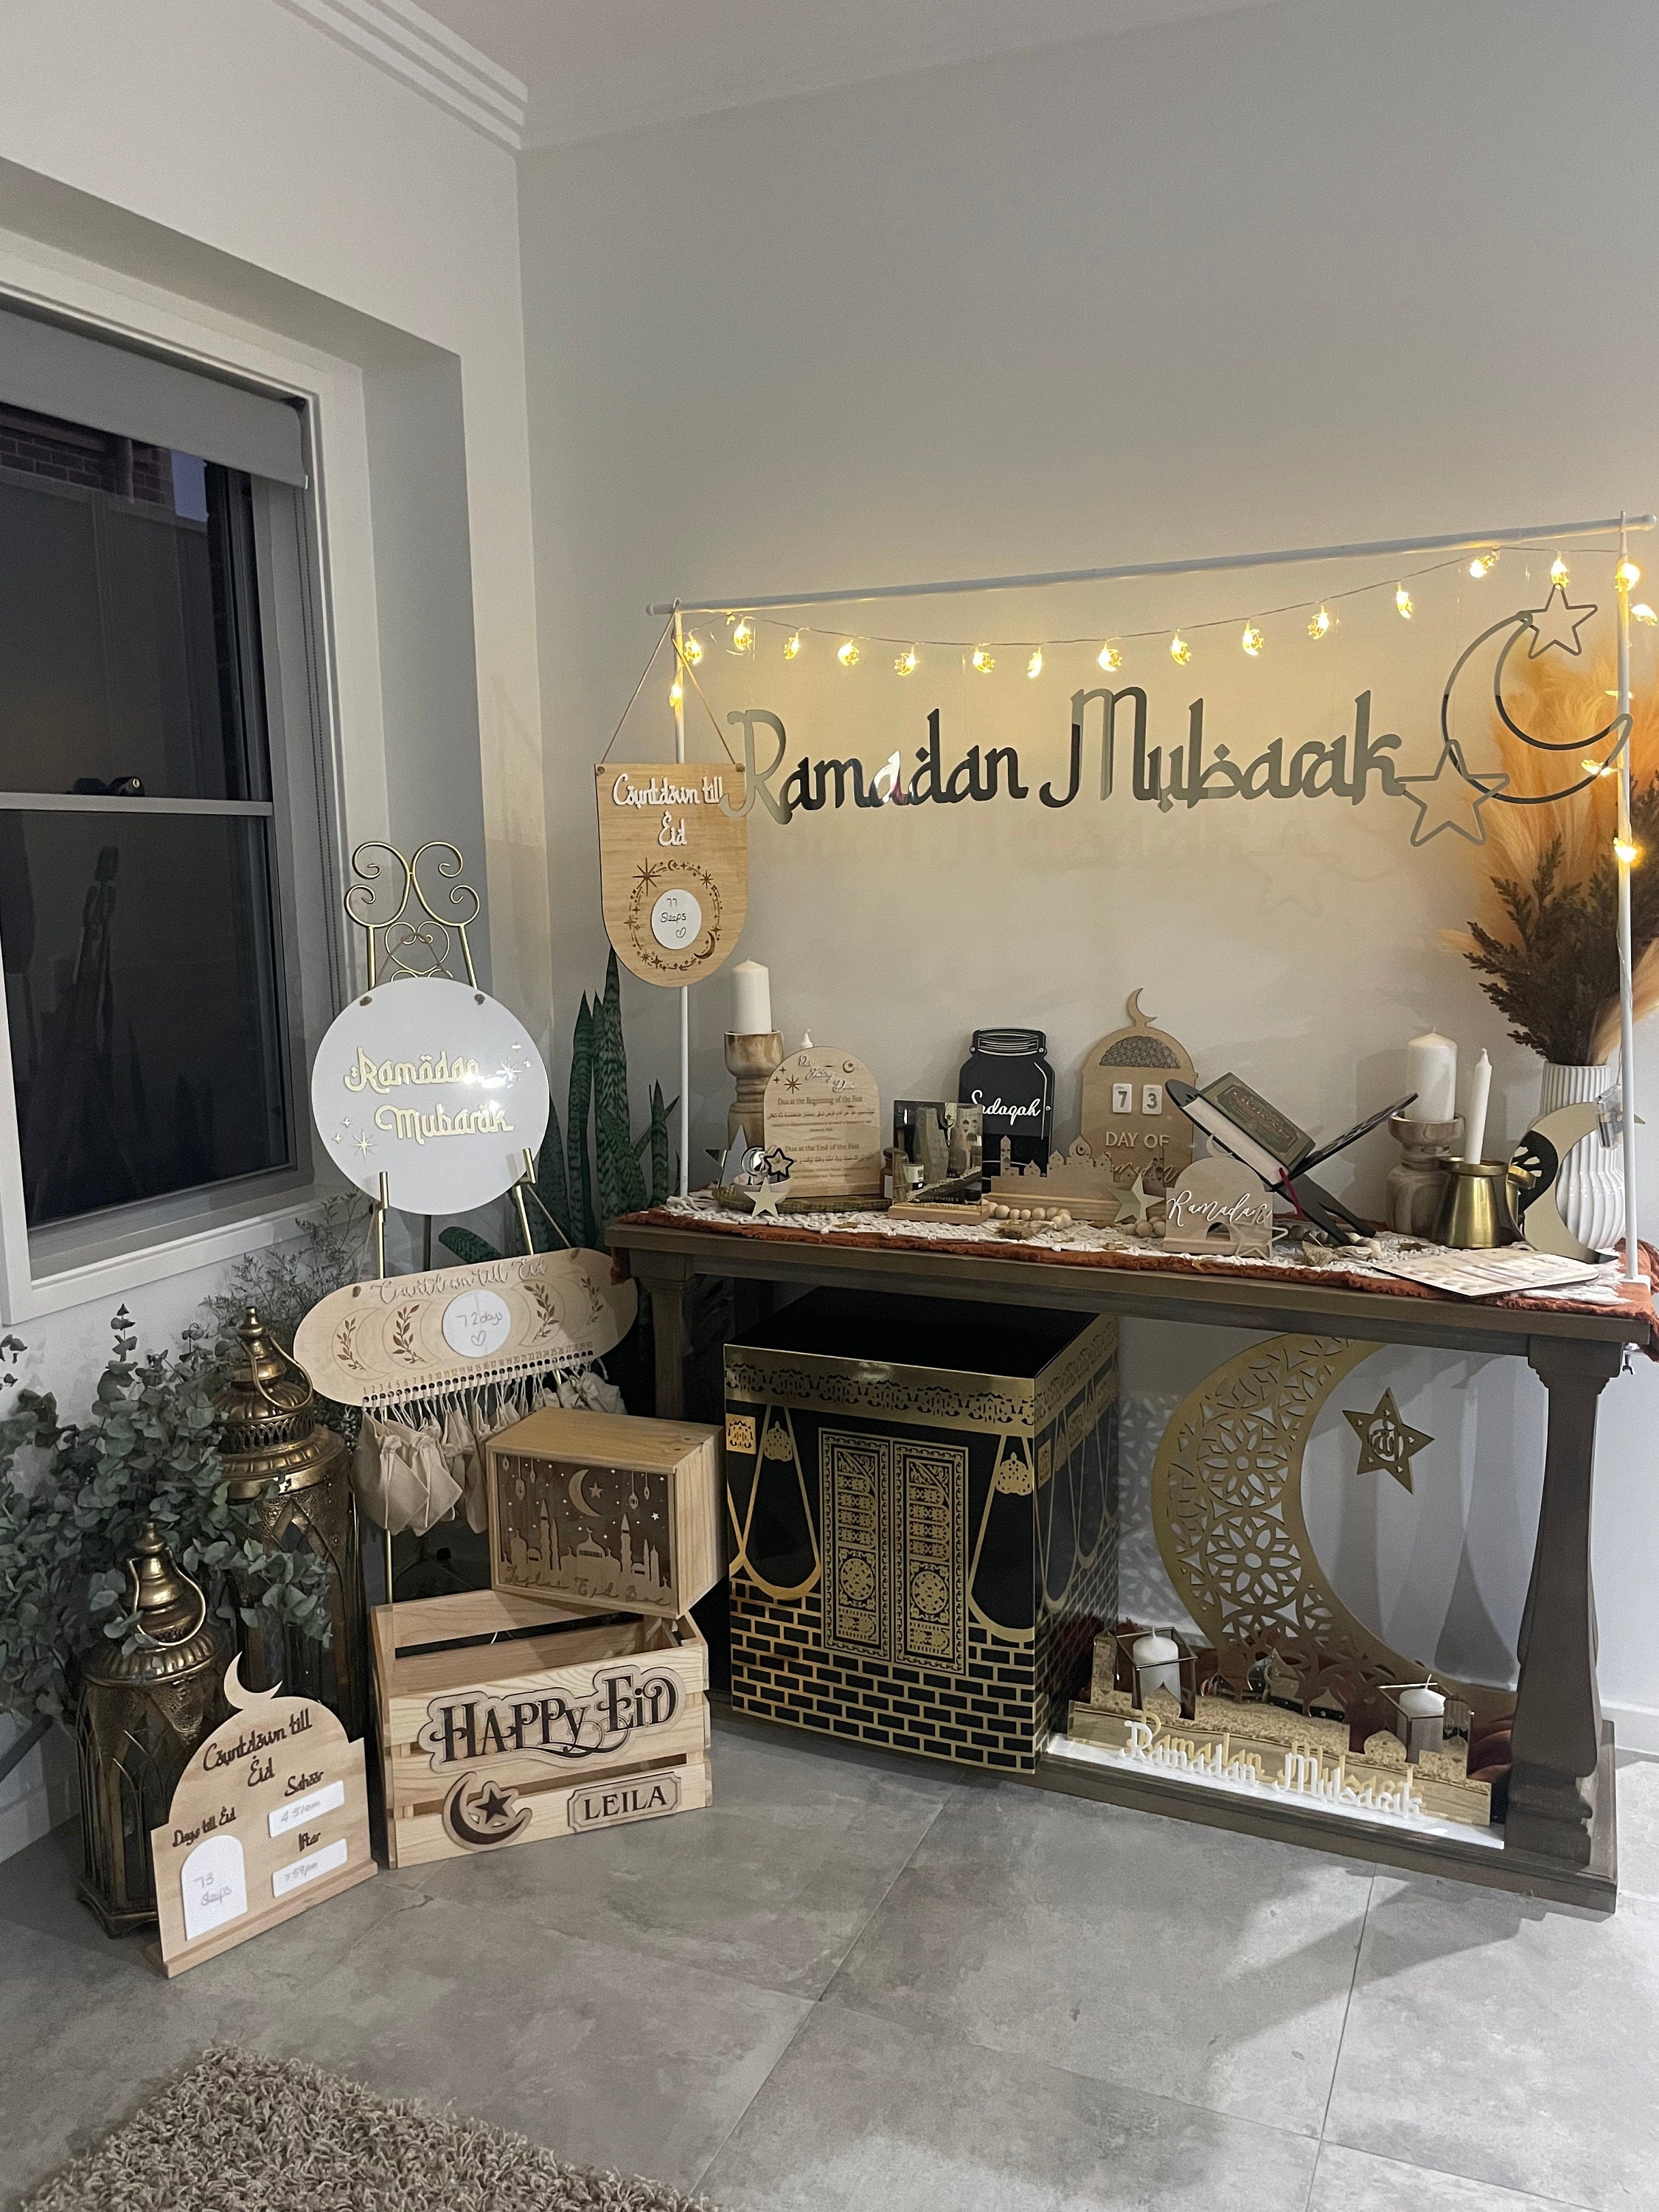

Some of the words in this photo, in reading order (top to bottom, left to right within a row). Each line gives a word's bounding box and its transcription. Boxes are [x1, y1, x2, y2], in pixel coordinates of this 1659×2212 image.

[719, 708, 1029, 824] Ramadan
[1038, 686, 1407, 813] Mubarak
[613, 773, 700, 809] Countdown
[702, 776, 723, 804] till
[658, 810, 687, 846] Eid
[344, 1046, 480, 1093] Ramadan
[375, 1103, 515, 1145] Mubarak
[1105, 1132, 1138, 1147] DAY
[1144, 1134, 1169, 1148] OF
[1166, 1190, 1273, 1227] Ramadan
[370, 1273, 474, 1304] Countdown
[472, 1263, 508, 1287] till
[511, 1256, 547, 1280] Eid
[203, 1728, 287, 1771] Countdown
[289, 1708, 313, 1735] till
[247, 1755, 275, 1787] Eid
[1118, 1719, 1262, 1789] Ramadan
[1270, 1751, 1425, 1819] Mubarak
[583, 1784, 667, 1821] LEILA
[173, 1828, 200, 1847] Days
[202, 1815, 218, 1834] till
[219, 1806, 237, 1826] Eid
